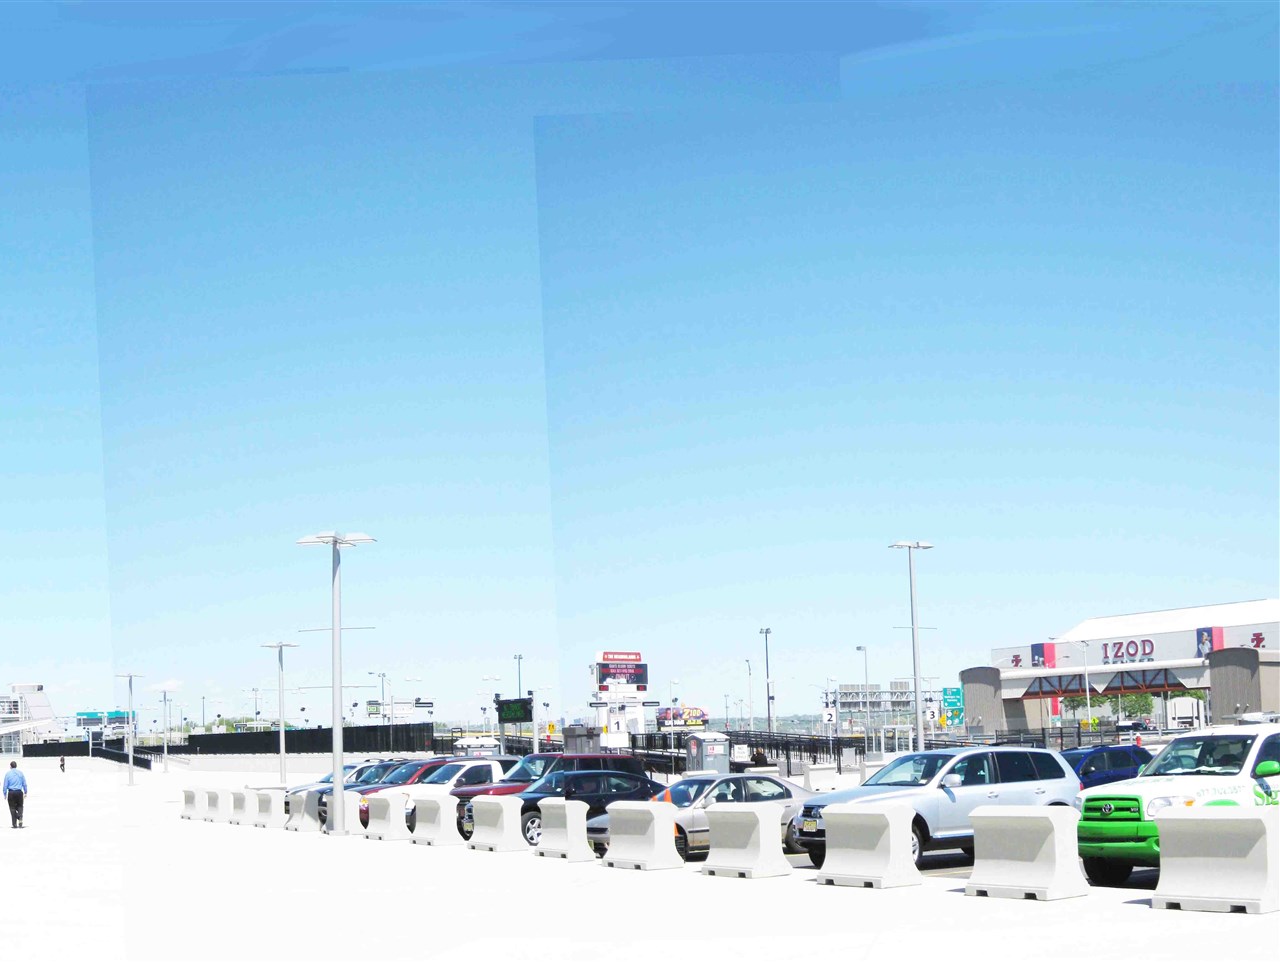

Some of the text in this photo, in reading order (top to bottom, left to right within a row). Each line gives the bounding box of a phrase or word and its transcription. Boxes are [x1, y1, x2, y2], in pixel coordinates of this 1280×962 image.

[1102, 639, 1155, 659] IZOD
[826, 713, 834, 722] 2
[930, 710, 936, 720] 3
[614, 721, 620, 731] 1
